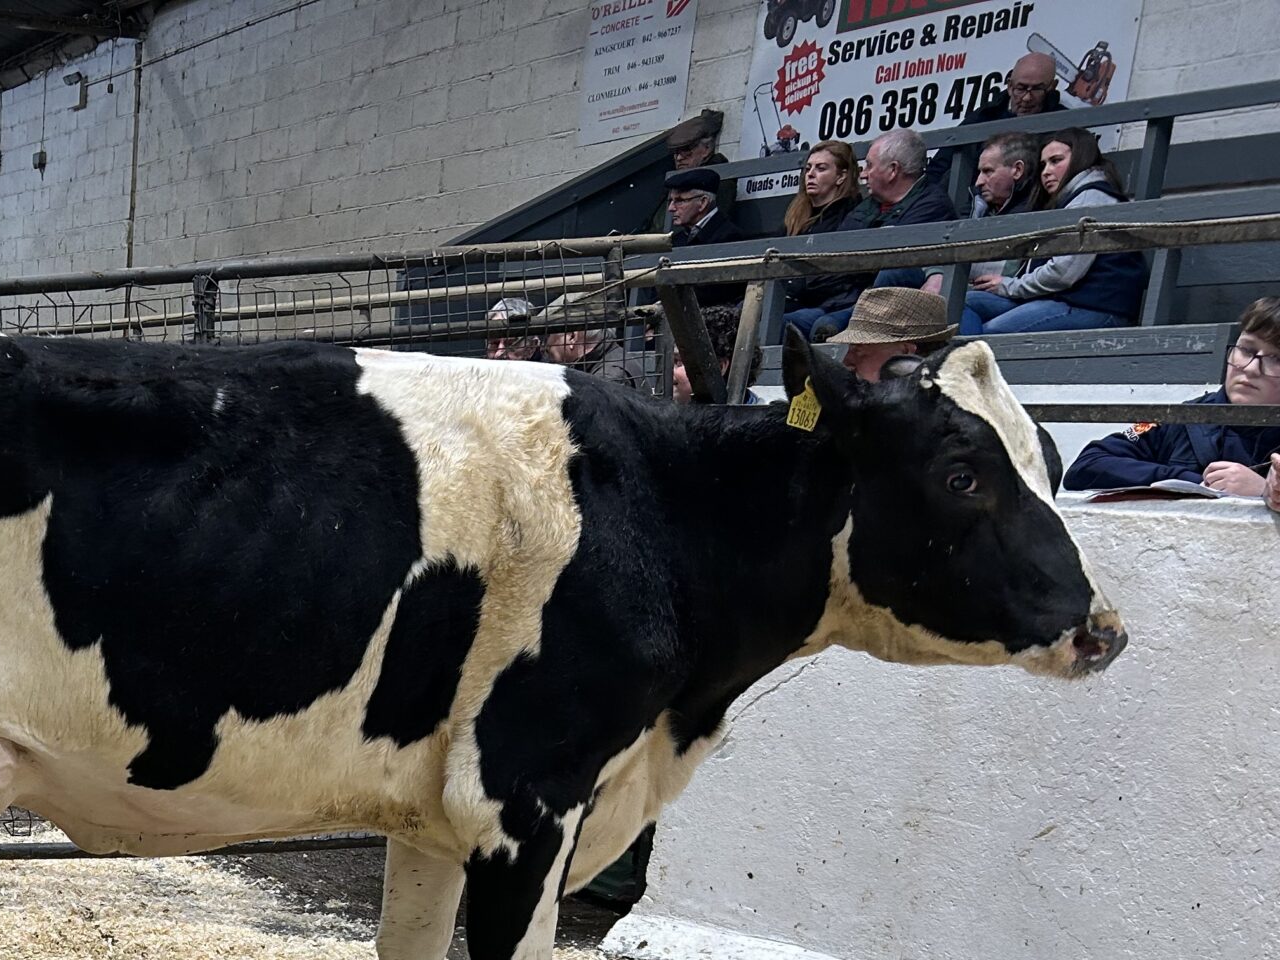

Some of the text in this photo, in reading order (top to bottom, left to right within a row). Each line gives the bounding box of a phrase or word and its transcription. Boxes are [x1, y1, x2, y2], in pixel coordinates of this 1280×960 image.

[600, 16, 640, 35] CONCRETE
[827, 30, 913, 65] Service
[920, 23, 937, 46] &
[943, 1, 1035, 42] Repair
[594, 37, 635, 56] KINGSCOURT
[604, 65, 620, 77] TRIM
[785, 51, 818, 82] free
[875, 52, 967, 84] Call John Now
[587, 85, 631, 103] CLONMELLON
[785, 71, 818, 96] pickup &
[785, 80, 818, 105] delivery!
[819, 68, 1013, 141] 086 358 476
[746, 176, 774, 194] Quads
